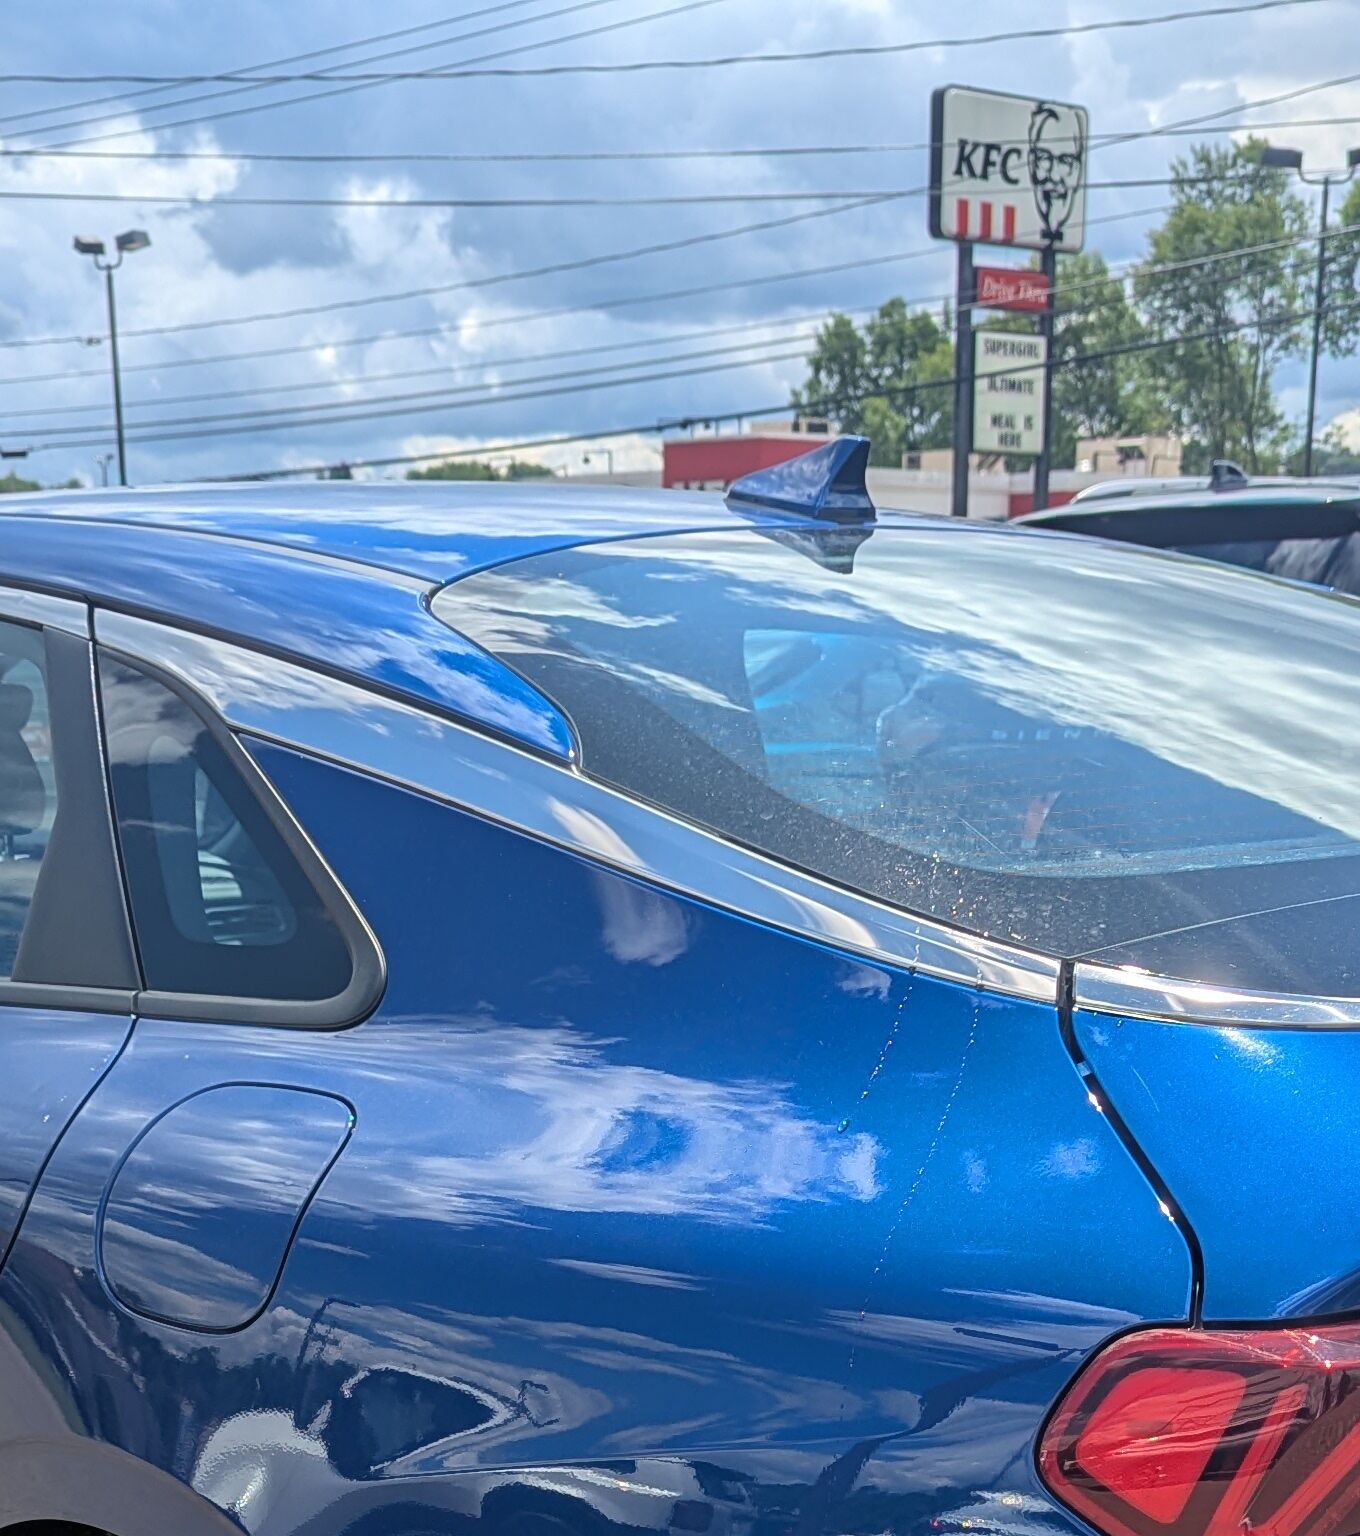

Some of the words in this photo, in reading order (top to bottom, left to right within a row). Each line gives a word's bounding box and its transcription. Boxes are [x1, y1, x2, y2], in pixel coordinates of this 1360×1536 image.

[952, 137, 1022, 185] KFC
[983, 337, 1040, 360] SUPERGIRL
[987, 374, 1034, 394] ULTIMATE
[991, 412, 1016, 430] MEAL
[1023, 414, 1033, 431] IS
[997, 432, 1022, 449] HERE
